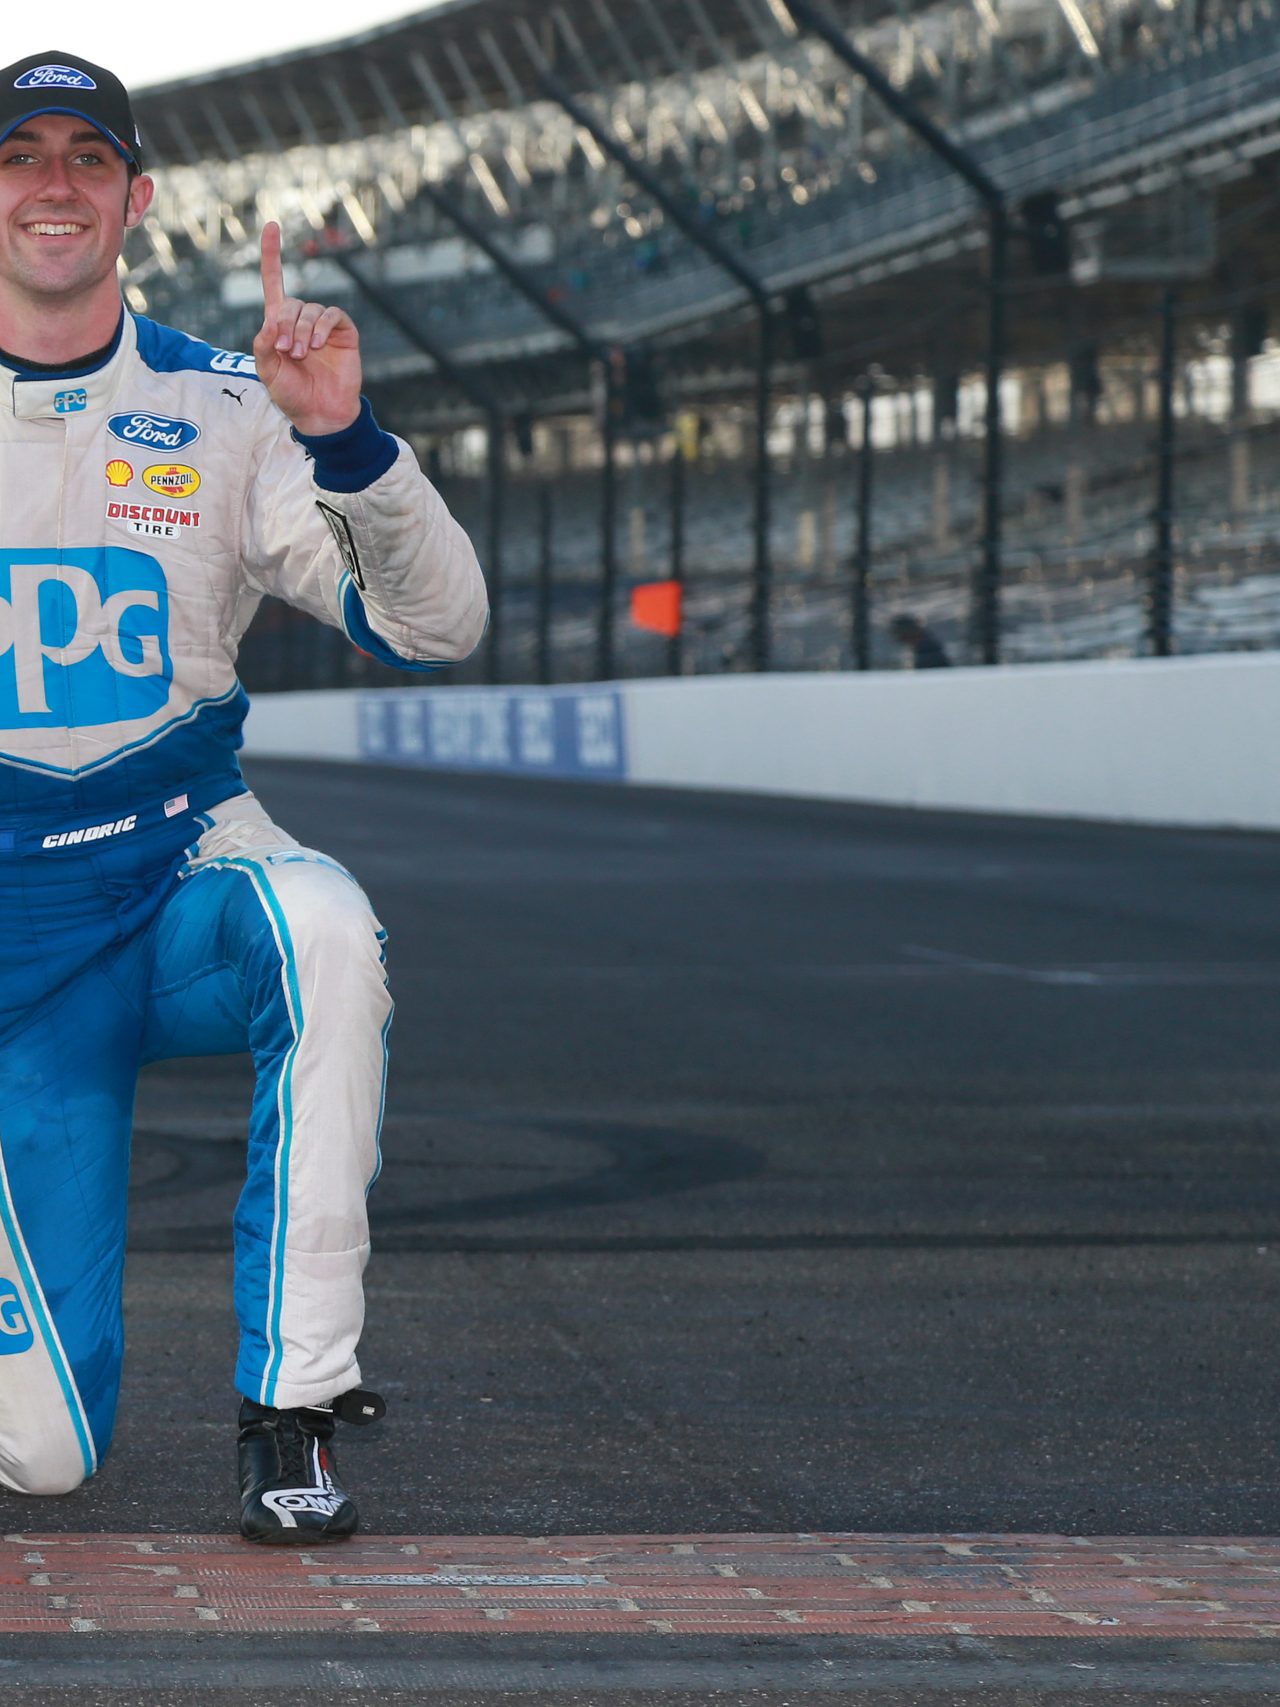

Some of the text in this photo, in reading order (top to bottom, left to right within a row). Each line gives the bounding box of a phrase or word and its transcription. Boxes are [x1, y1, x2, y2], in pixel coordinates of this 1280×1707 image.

[28, 67, 82, 86] Ford
[216, 352, 256, 369] PP
[55, 391, 86, 411] PPG
[123, 415, 182, 446] Ford
[150, 472, 193, 486] PENNZOIL
[107, 502, 200, 527] DISCOUNT
[133, 522, 174, 536] TIRE
[42, 815, 137, 849] CINDRIC
